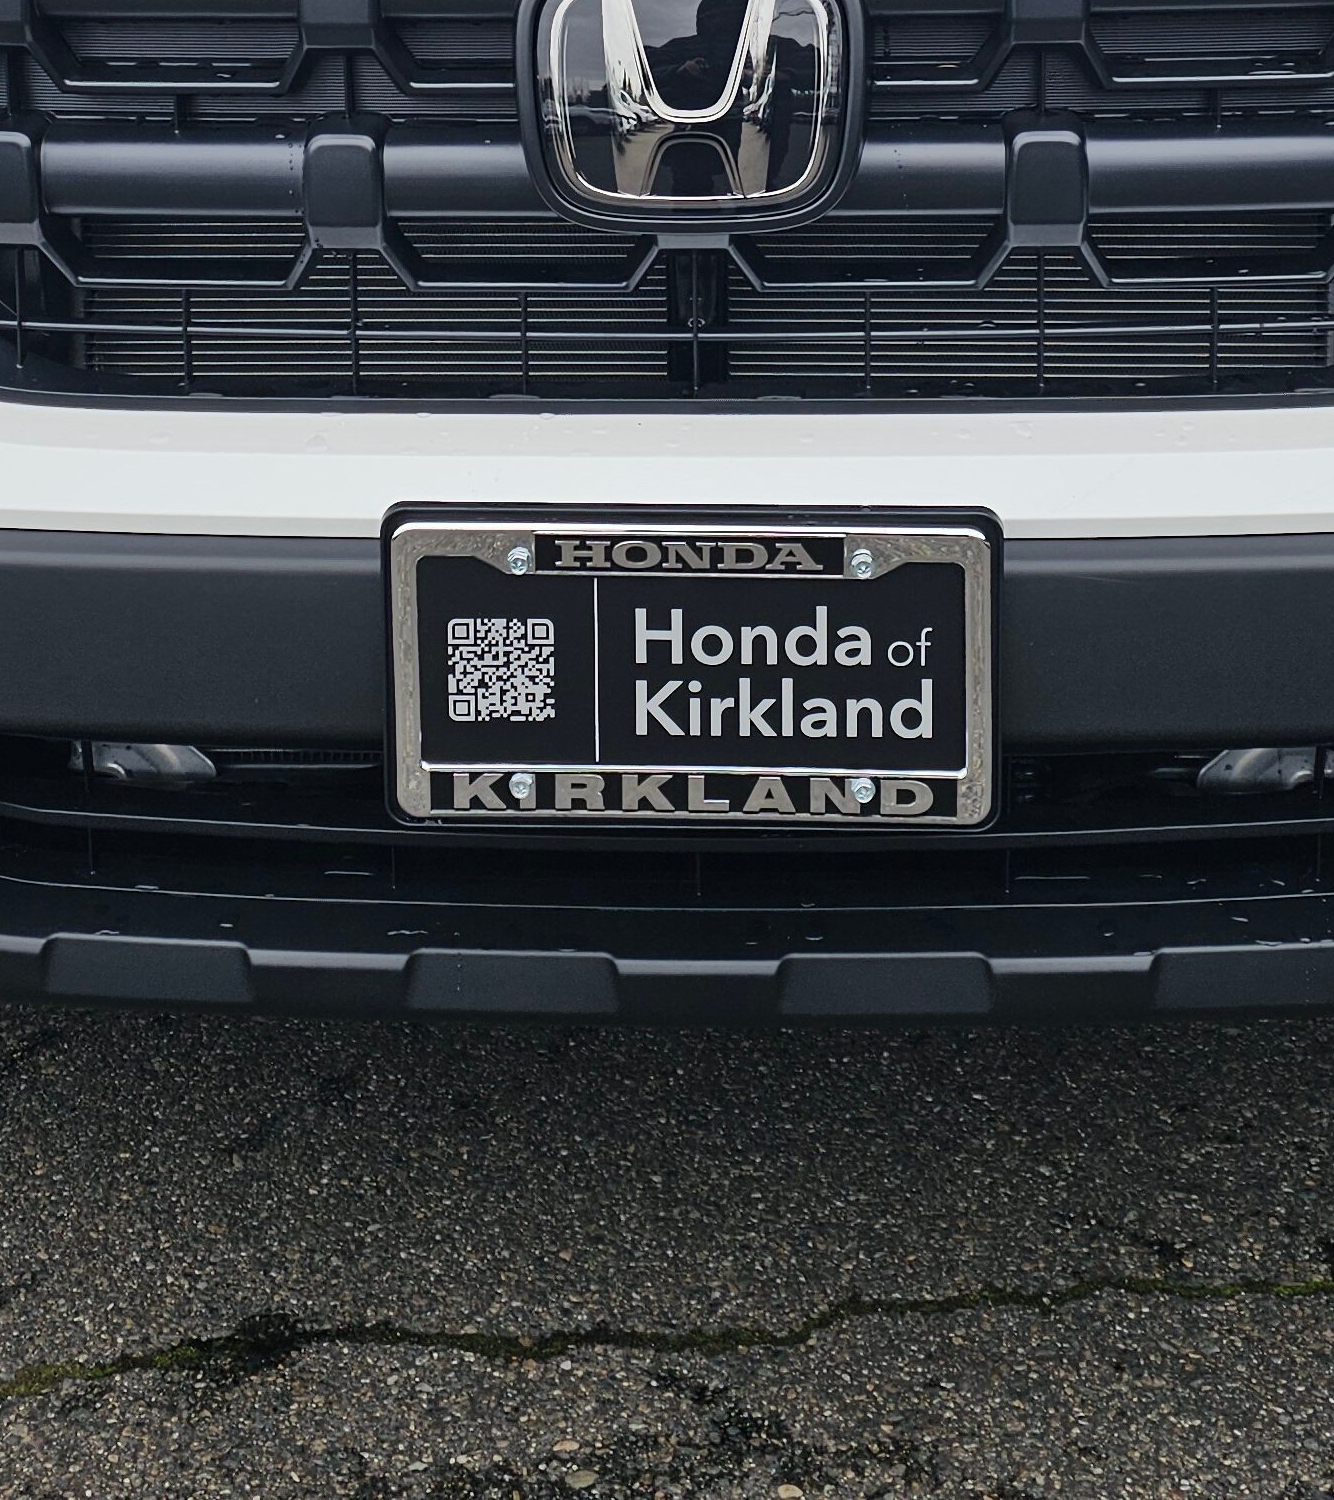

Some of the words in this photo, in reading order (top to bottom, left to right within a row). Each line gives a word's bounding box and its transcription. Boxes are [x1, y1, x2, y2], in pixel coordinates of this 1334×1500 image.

[555, 540, 824, 571] HONDA
[635, 605, 872, 666] Honda
[887, 627, 933, 667] of
[635, 677, 933, 739] Kirkland
[453, 772, 934, 816] KIRKLAND
